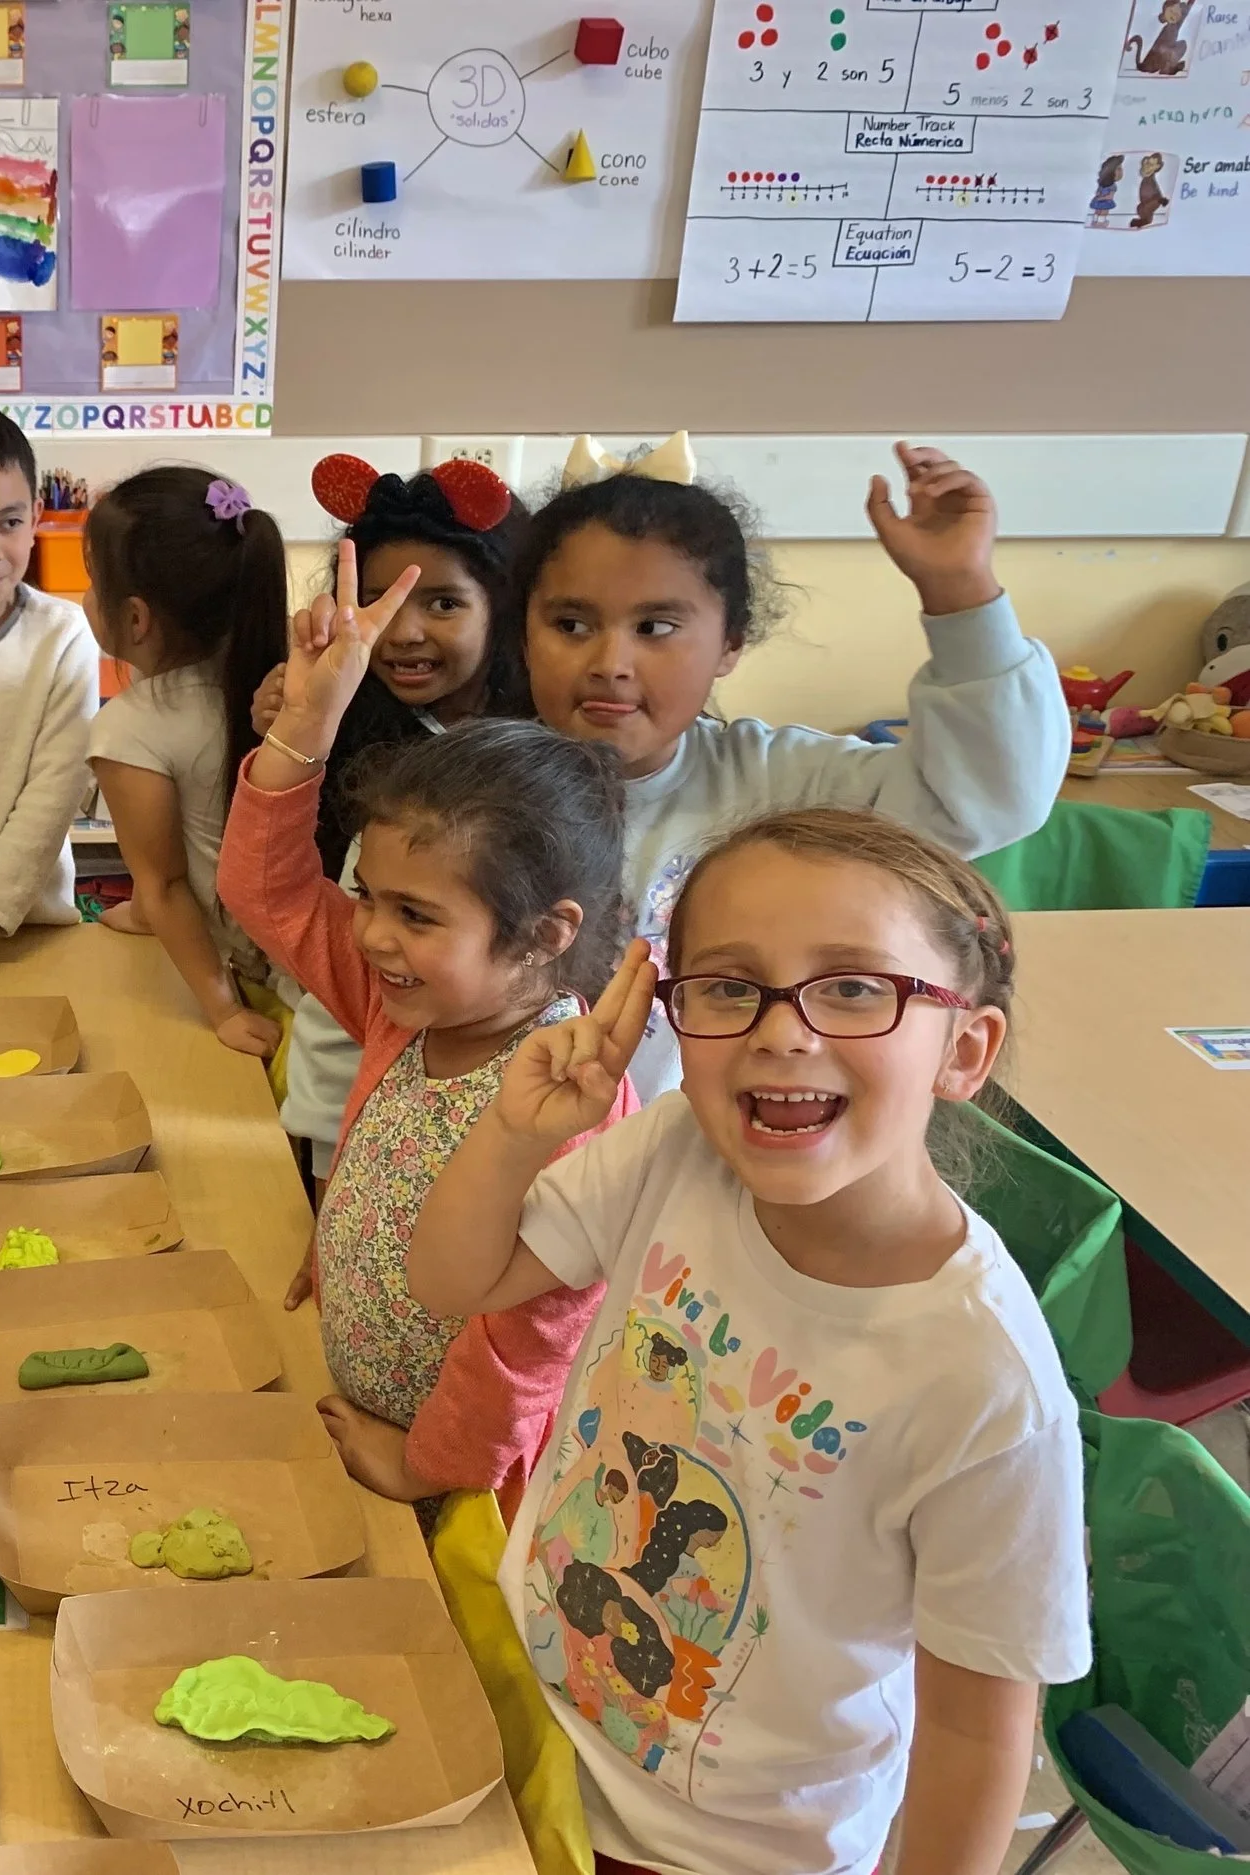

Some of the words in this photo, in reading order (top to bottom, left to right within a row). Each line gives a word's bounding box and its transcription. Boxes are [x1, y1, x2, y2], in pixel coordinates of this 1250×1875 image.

[360, 5, 392, 21] hexa
[627, 36, 669, 60] cubo
[625, 63, 663, 80] cube
[749, 60, 764, 82] 3
[816, 61, 829, 81] 2
[841, 68, 868, 81] son
[878, 58, 895, 83] 5
[452, 64, 506, 109] 3D
[942, 82, 961, 106] 5
[970, 94, 1009, 107] menos
[1020, 87, 1034, 107] 2
[1047, 96, 1069, 109] son
[1076, 87, 1093, 110] 3
[306, 101, 366, 126] esfera
[863, 115, 911, 132] Number
[915, 115, 956, 132] Track
[855, 131, 893, 149] Recta
[601, 153, 647, 169] cono
[1183, 156, 1210, 174] Ser
[599, 175, 639, 186] cone
[1180, 181, 1198, 200] Be
[1208, 181, 1239, 197] kind
[335, 217, 401, 239] cilindro
[845, 222, 912, 246] Equation
[334, 241, 391, 259] cilinder
[845, 245, 911, 261] Ecuación
[642, 1241, 703, 1322] Viva
[57, 1475, 148, 1502] Itza
